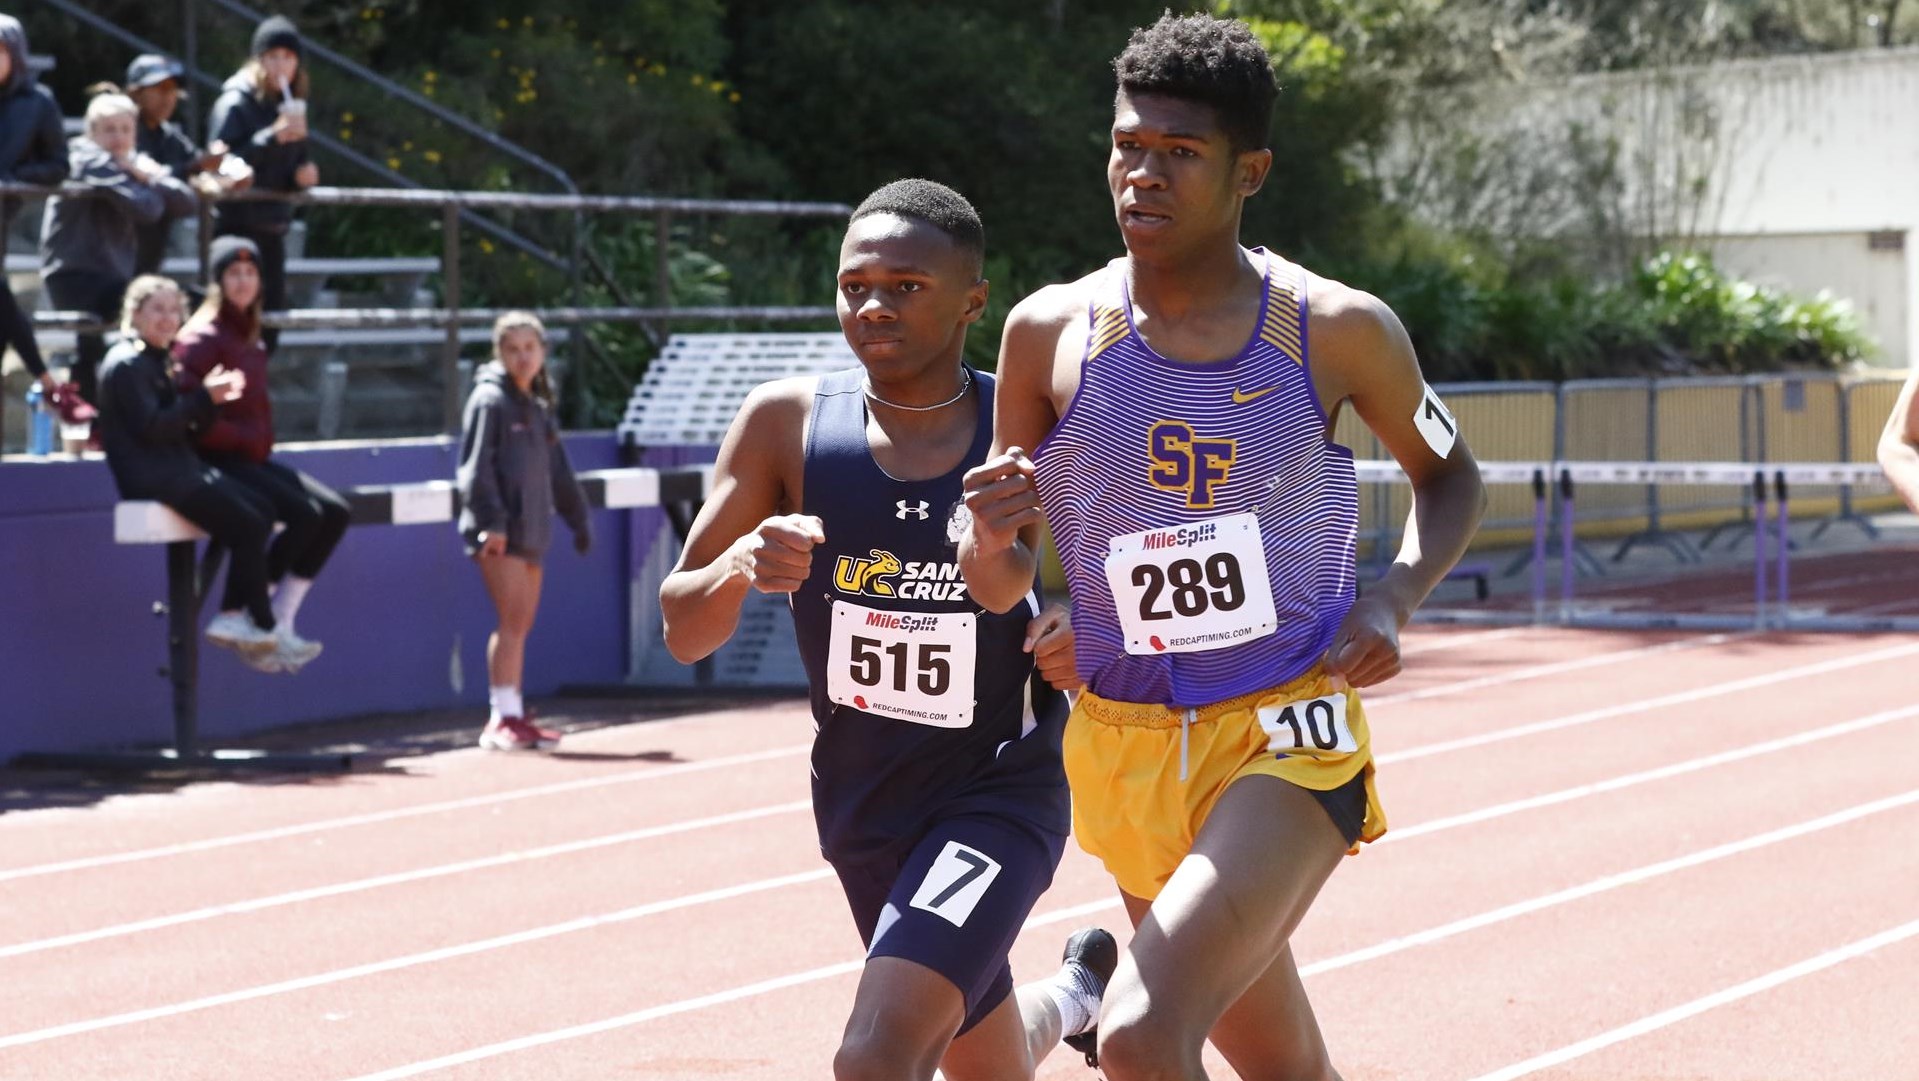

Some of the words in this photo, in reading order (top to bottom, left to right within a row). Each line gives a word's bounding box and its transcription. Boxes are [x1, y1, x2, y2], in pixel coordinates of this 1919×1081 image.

[1147, 420, 1237, 509] SF
[1143, 522, 1218, 551] MileSplit
[901, 562, 965, 581] SAN
[898, 582, 968, 601] CRUZ
[1131, 552, 1246, 621] 289
[866, 611, 939, 634] MileSplit
[1169, 626, 1253, 648] REDCAPTIMING.COM
[849, 634, 952, 697] 515
[872, 702, 948, 722] REDCAPTIMING.COM
[1275, 699, 1339, 751] 10
[927, 848, 990, 909] 7
